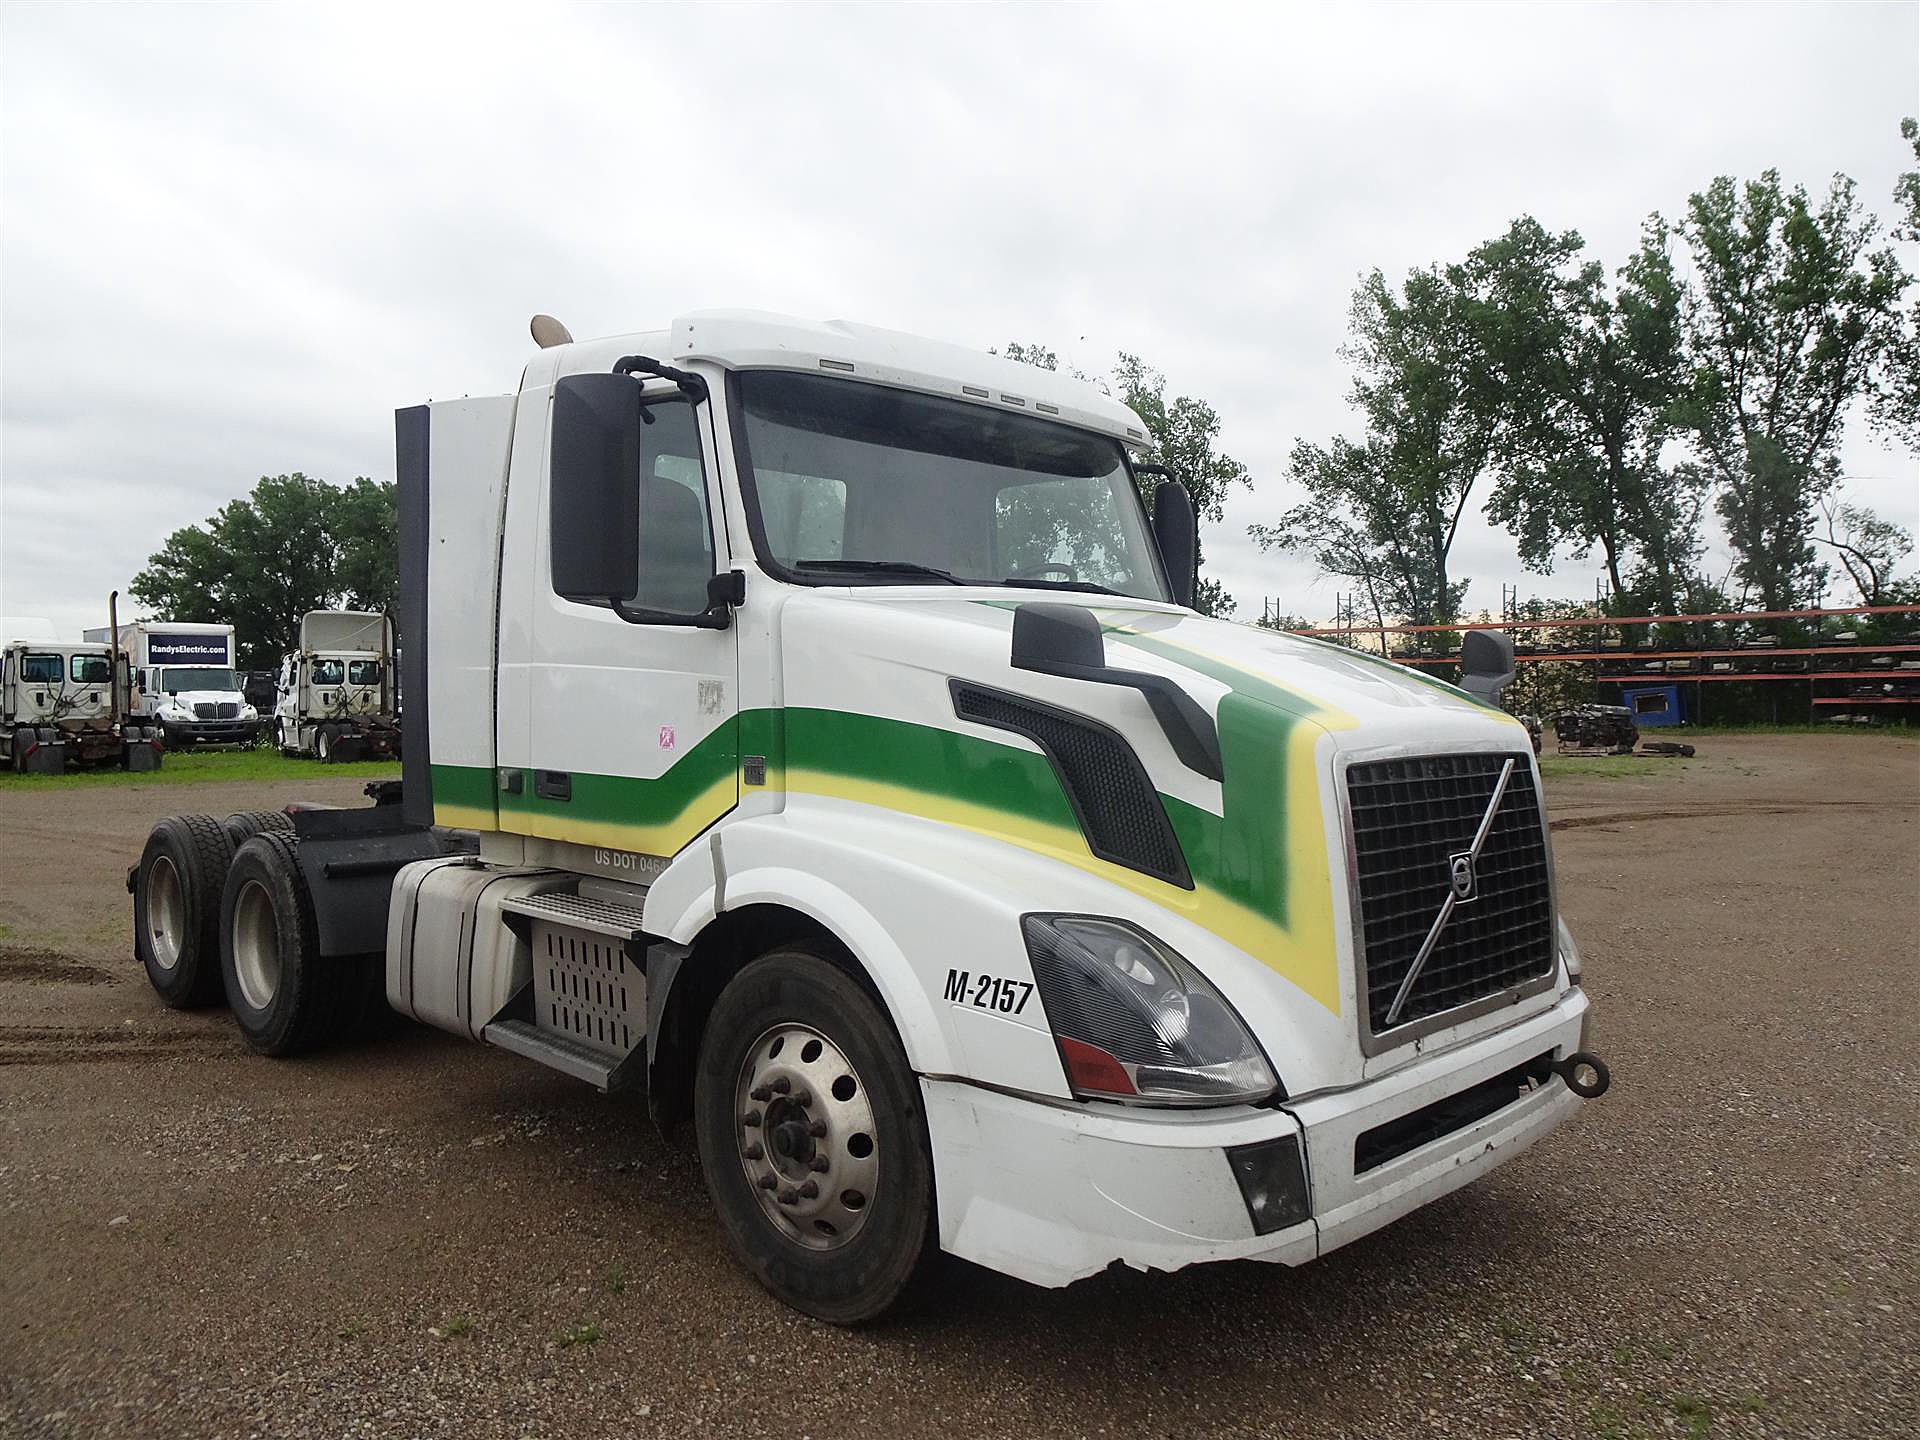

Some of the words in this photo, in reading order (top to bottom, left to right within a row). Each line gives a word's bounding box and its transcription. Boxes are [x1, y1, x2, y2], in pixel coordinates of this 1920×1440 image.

[151, 645, 226, 655] RandysElectric.com
[595, 849, 610, 866] US
[613, 852, 637, 871] DOT
[943, 968, 1034, 1015] M-2157
